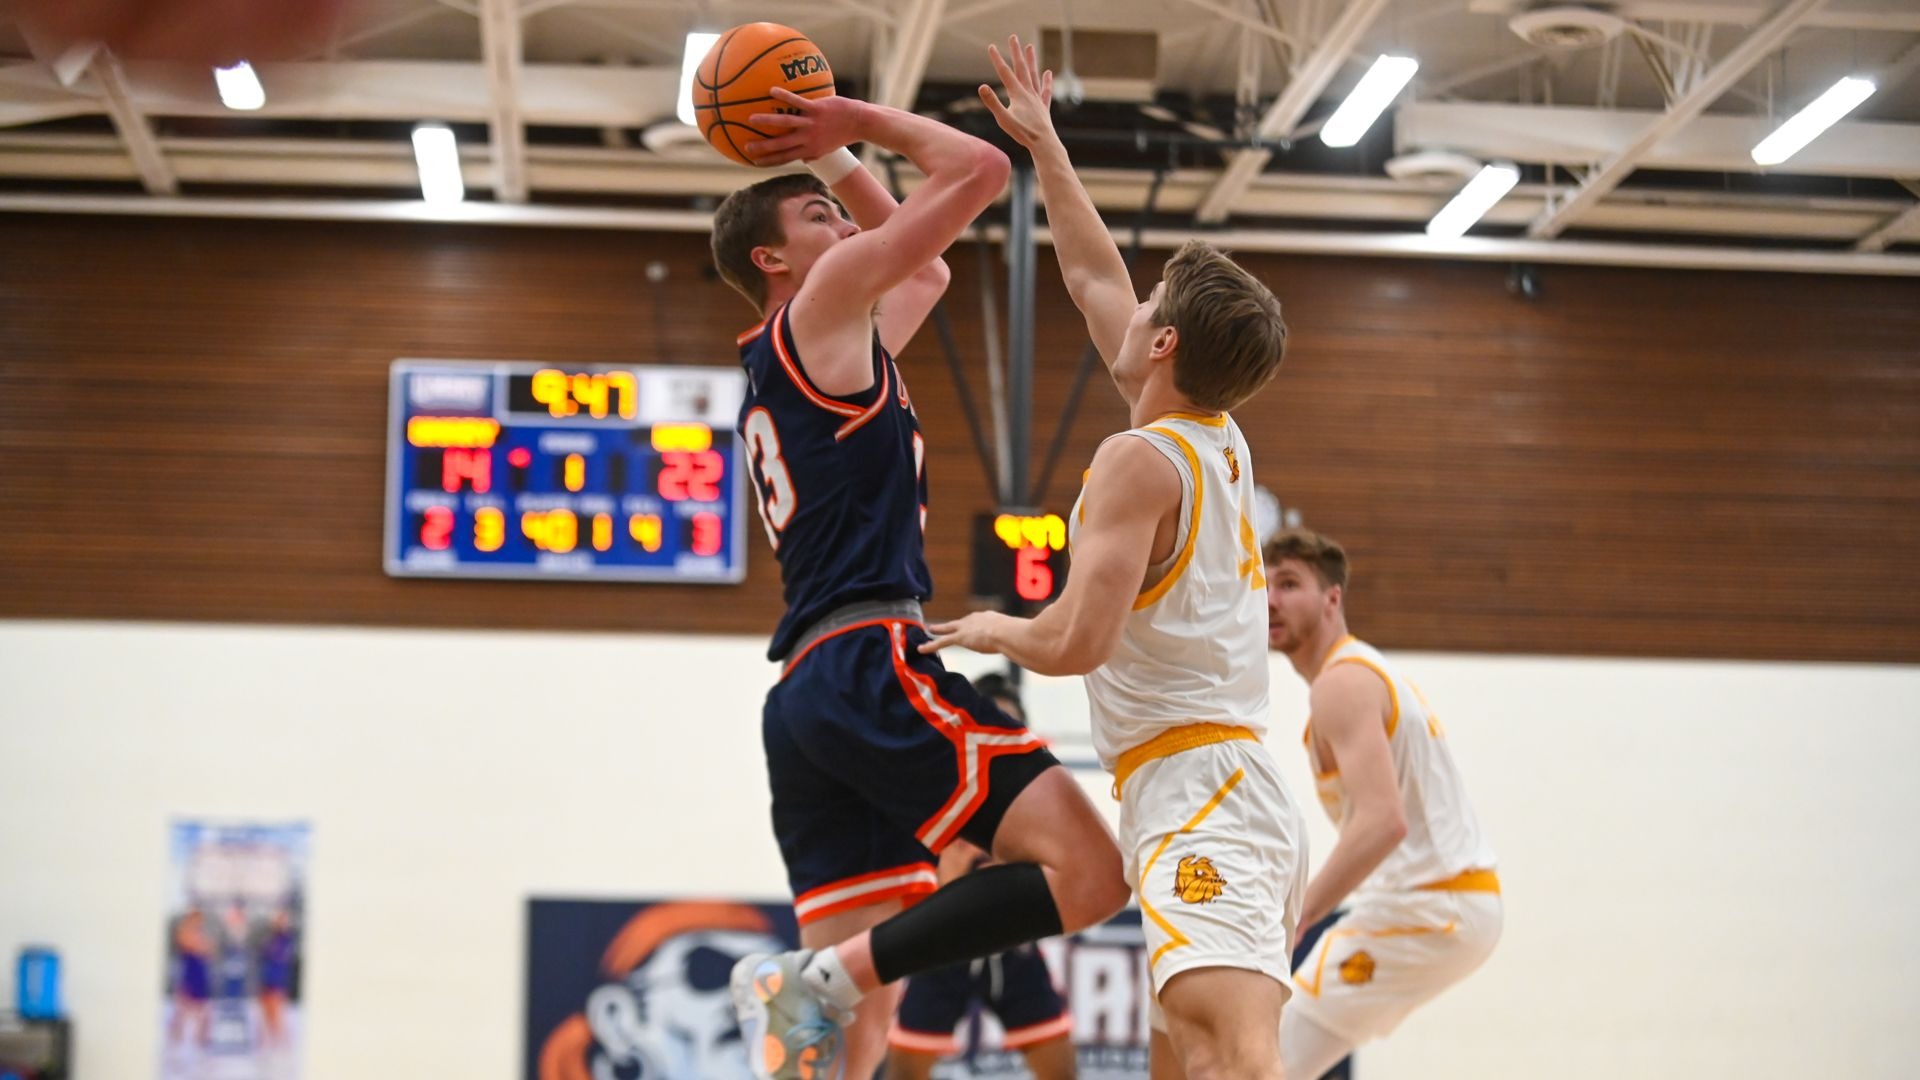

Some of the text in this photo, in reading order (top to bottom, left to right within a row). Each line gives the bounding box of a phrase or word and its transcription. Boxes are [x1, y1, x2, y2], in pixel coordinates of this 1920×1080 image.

[780, 55, 829, 82] NCAA
[532, 370, 638, 420] 9:47
[442, 447, 492, 493] 14
[564, 453, 585, 492] 1
[658, 450, 724, 501] 22
[421, 506, 454, 550] 2
[1016, 546, 1052, 601] 6
